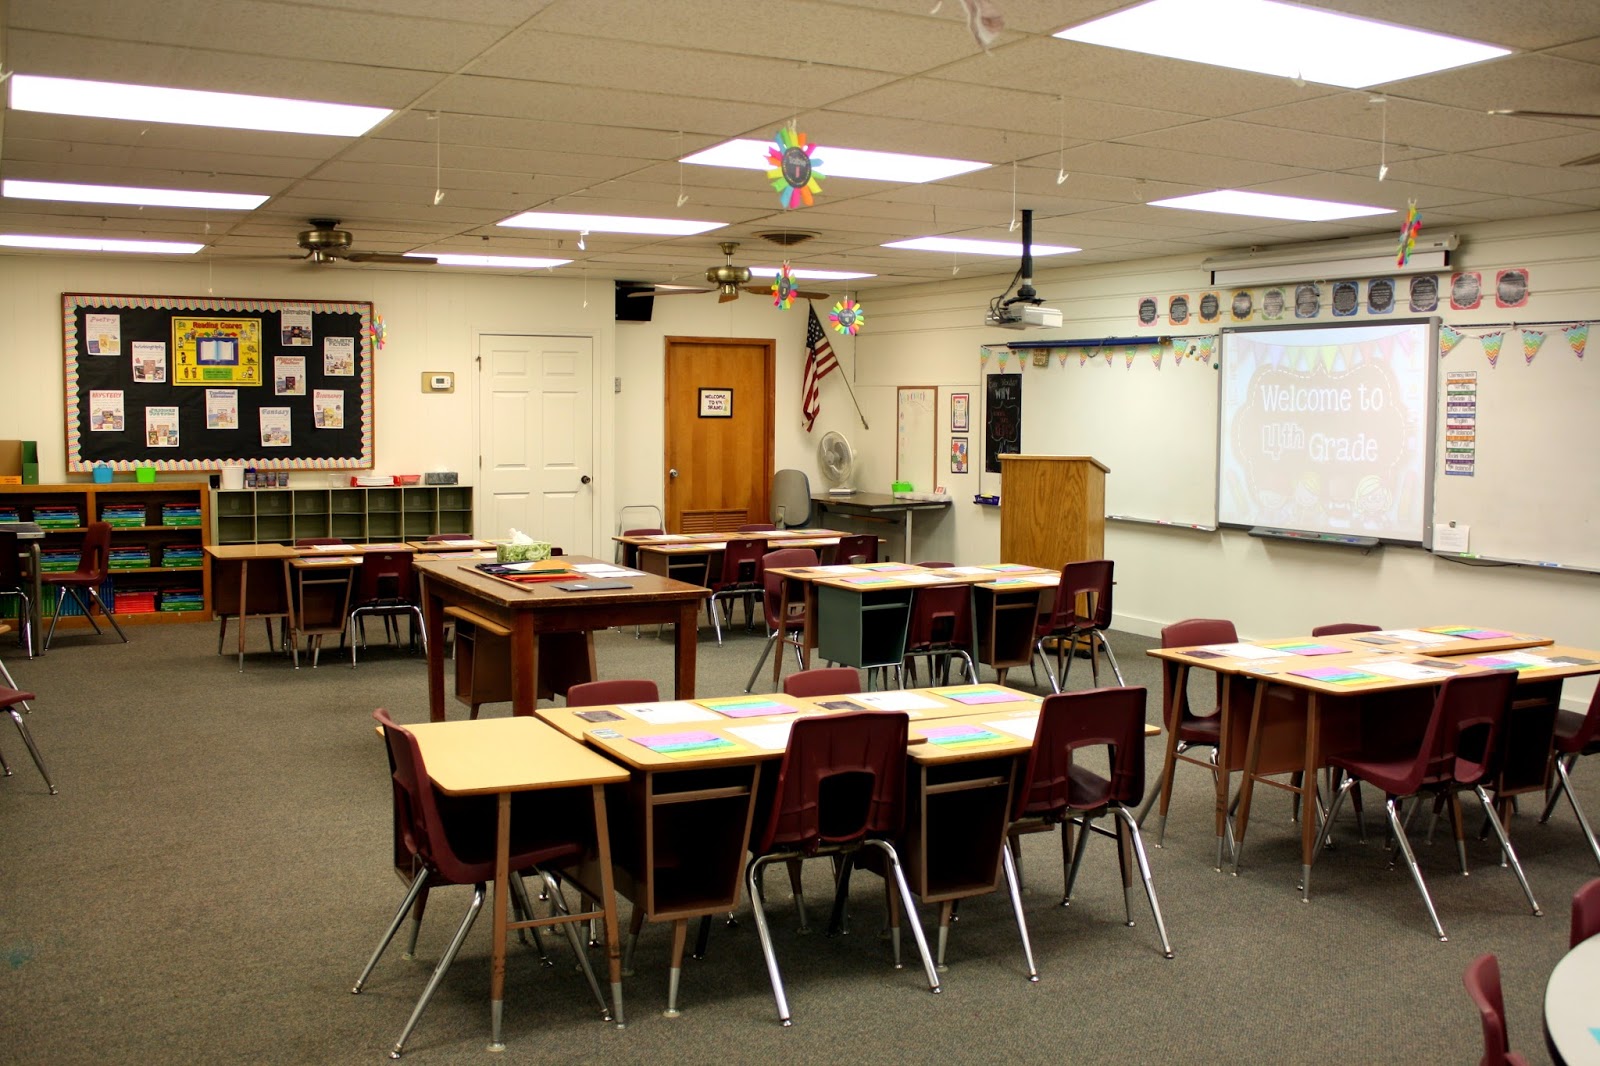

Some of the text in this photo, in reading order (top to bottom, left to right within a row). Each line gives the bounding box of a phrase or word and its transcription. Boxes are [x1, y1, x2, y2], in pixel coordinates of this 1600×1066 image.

[192, 321, 219, 329] Reading
[1260, 383, 1384, 413] Welcome to
[1262, 422, 1378, 462] 4th Grade
